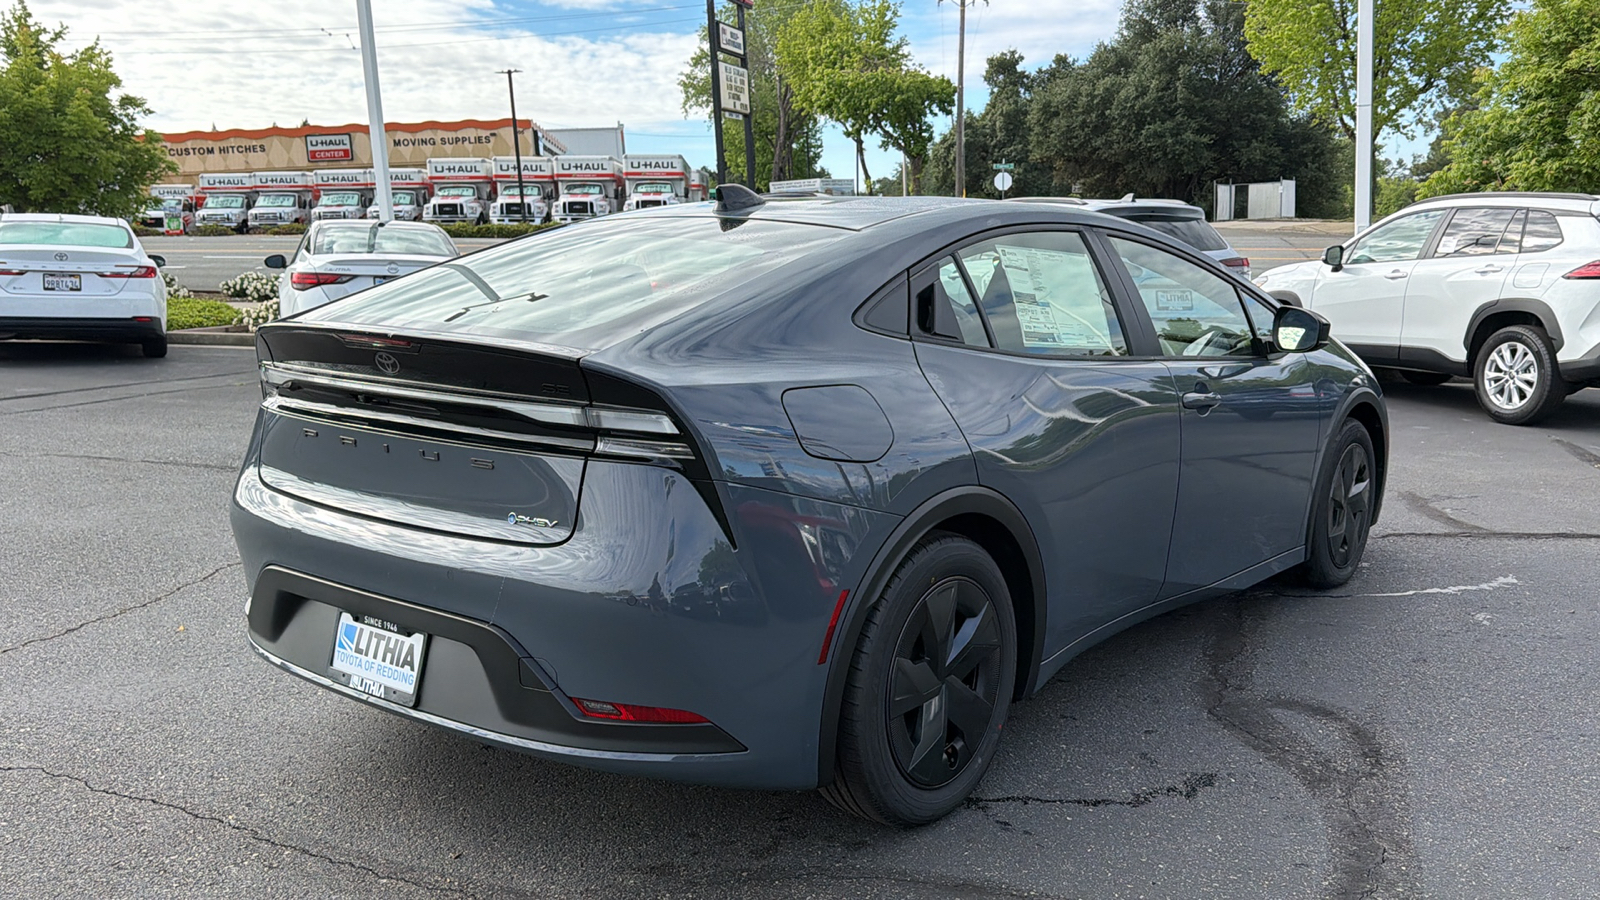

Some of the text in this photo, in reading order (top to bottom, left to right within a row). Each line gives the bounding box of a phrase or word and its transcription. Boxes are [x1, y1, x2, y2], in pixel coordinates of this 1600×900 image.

[310, 139, 347, 147] U-HAUL
[393, 135, 491, 147] MOVING SUPPLIES
[168, 144, 266, 157] CUSTOM HITCHES
[434, 165, 481, 173] U-HAUL
[561, 163, 607, 171] U-HAUL
[630, 161, 677, 169] U-HAUL
[1166, 294, 1190, 302] LITHIA
[303, 428, 494, 470] PRIUS
[364, 615, 397, 632] SINCE 1946
[354, 628, 415, 672] LITHIA
[337, 650, 414, 686] TOYOTA OF REDDING
[359, 677, 385, 698] LITHIA
